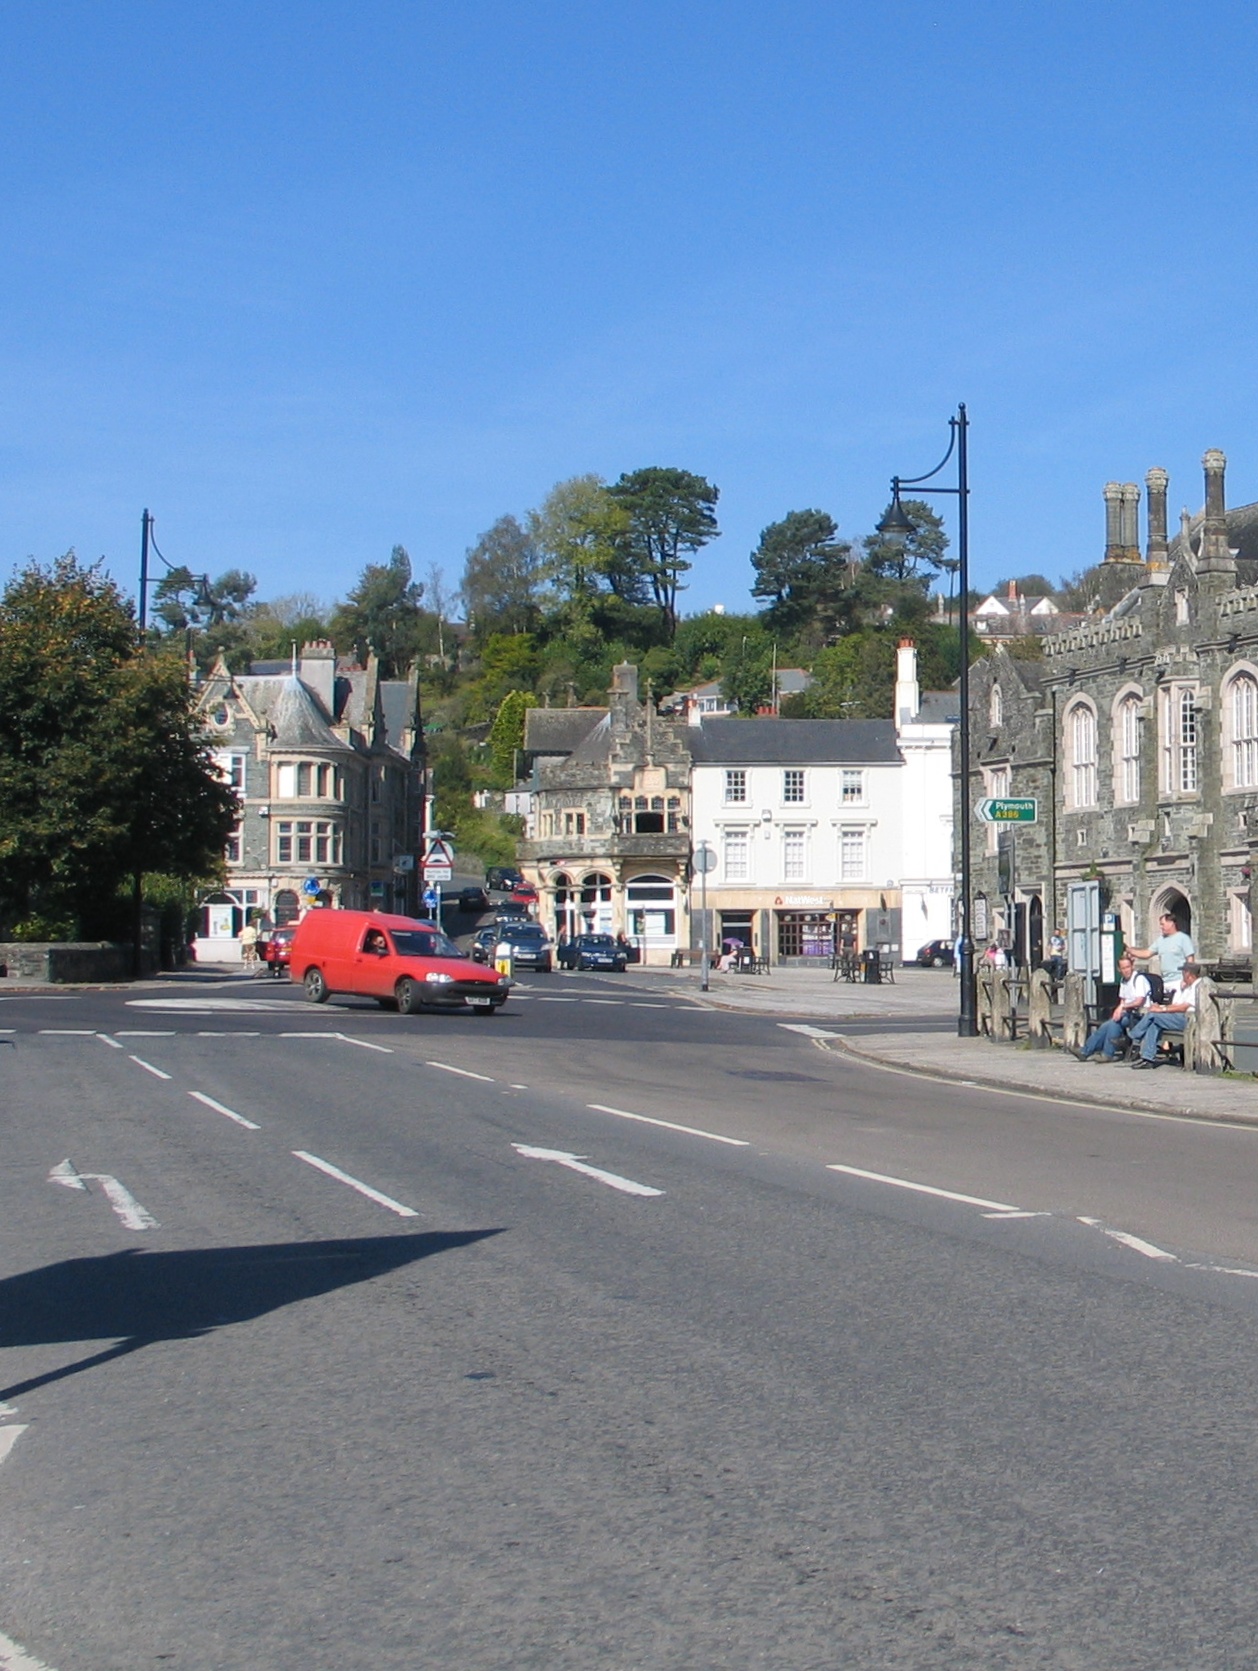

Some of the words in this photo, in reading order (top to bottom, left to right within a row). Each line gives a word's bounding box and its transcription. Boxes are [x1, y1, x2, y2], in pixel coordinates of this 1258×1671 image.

[995, 801, 1034, 811] Plymouth
[785, 895, 824, 905] NatWest
[1104, 914, 1113, 923] P
